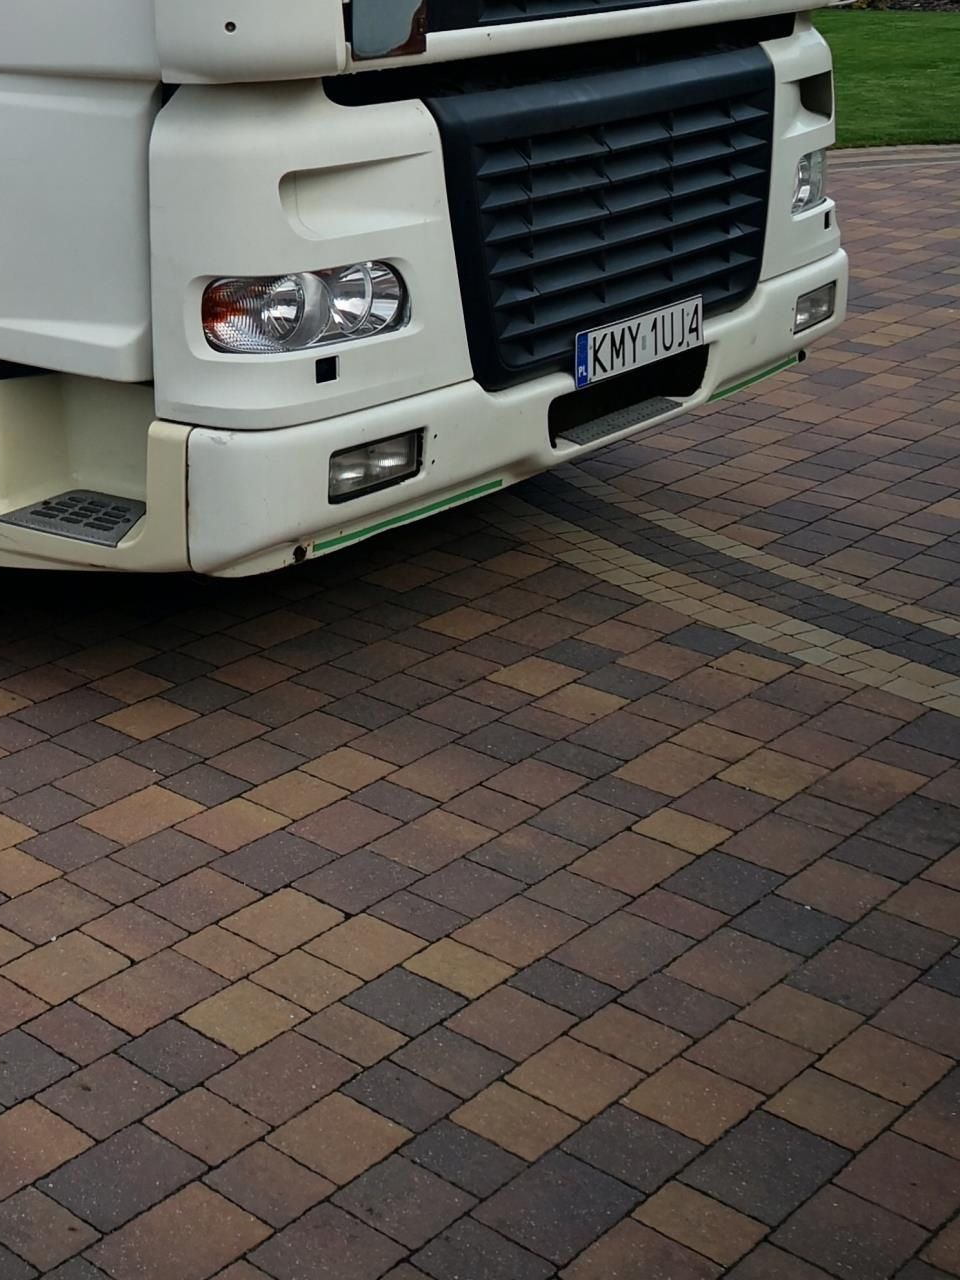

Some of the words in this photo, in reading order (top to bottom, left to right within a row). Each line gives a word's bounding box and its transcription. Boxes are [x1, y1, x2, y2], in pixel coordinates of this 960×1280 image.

[592, 322, 641, 377] KMY
[650, 303, 700, 357] 1UJ4
[578, 364, 588, 378] PL
